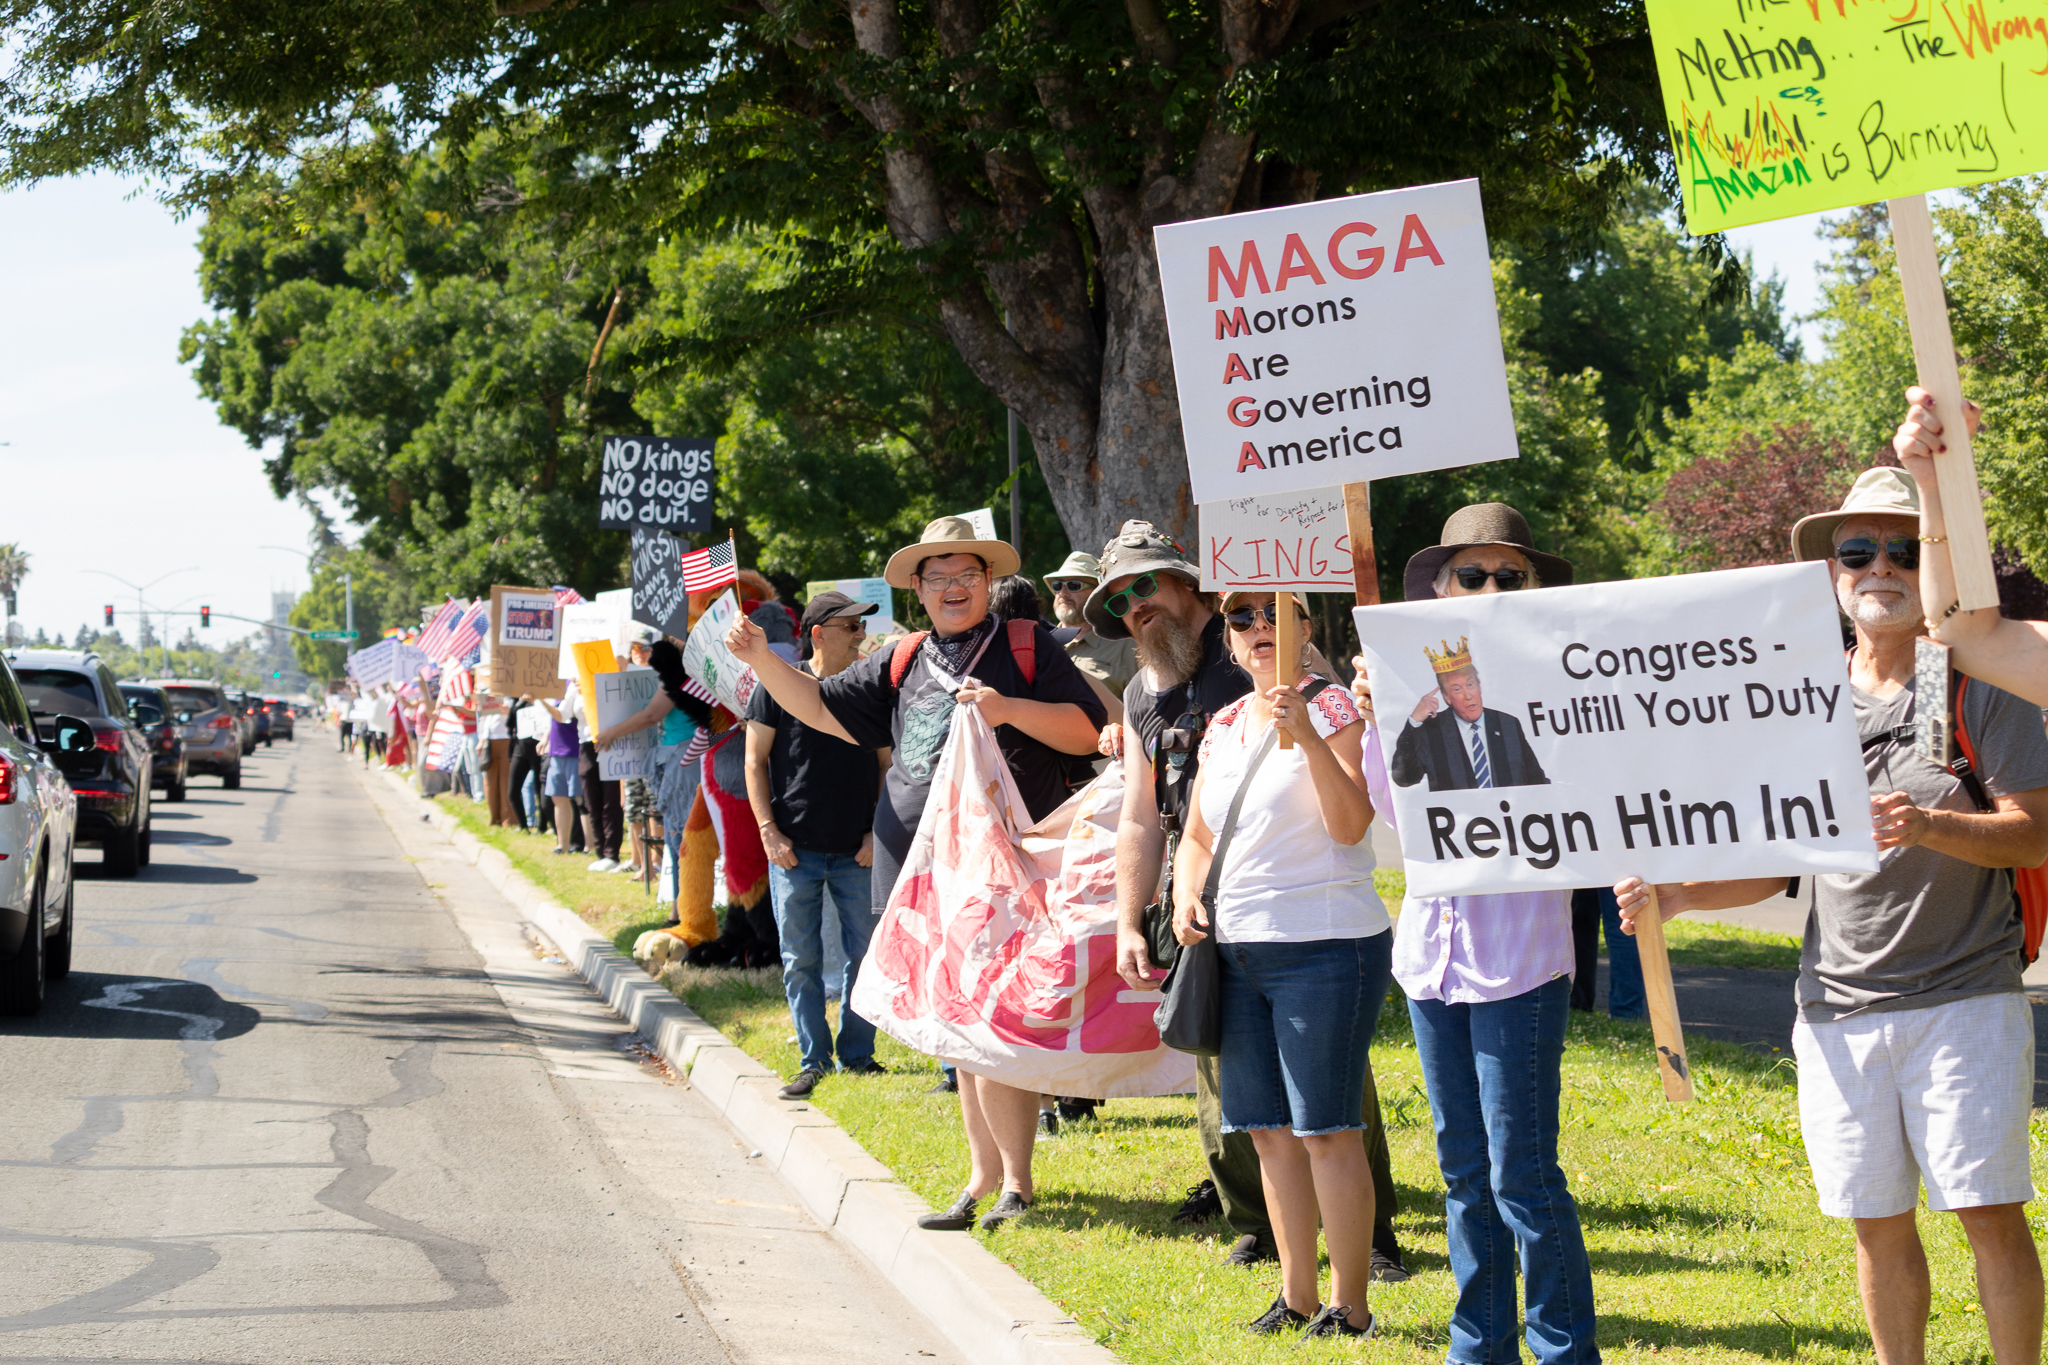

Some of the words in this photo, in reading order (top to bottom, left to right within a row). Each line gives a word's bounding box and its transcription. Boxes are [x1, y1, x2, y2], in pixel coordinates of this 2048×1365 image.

[1883, 19, 1957, 64] The
[1686, 128, 1812, 216] Amazon
[1821, 142, 1850, 182] is
[1858, 61, 2025, 185] Burning!
[1207, 213, 1446, 303] MAGA
[1215, 297, 1357, 341] Morons
[1222, 352, 1290, 385] Are
[1227, 375, 1432, 428] Governing
[602, 437, 642, 473] NO
[642, 441, 712, 479] kings
[1236, 425, 1403, 474] America
[600, 470, 635, 497] NO
[639, 471, 709, 507] doge
[600, 498, 634, 521] NO
[1228, 496, 1255, 515] Fight
[1256, 504, 1270, 517] for
[1275, 501, 1310, 519] Dignity
[1297, 509, 1326, 527] Respect
[1326, 501, 1339, 513] for
[631, 527, 646, 548] NO
[1211, 533, 1354, 580] KINGS
[508, 600, 554, 611] PRO-AMERICA
[633, 568, 670, 611] CLAWS
[647, 584, 673, 617] VOTE
[656, 576, 685, 627] SHARP
[507, 610, 534, 625] STOP
[507, 626, 553, 640] TRUMP
[493, 667, 515, 684] IN
[496, 648, 517, 667] NO
[1561, 635, 1759, 683] Congress
[1527, 693, 1626, 738] Fulfill
[1634, 690, 1731, 729] Your
[1744, 676, 1842, 724] Duty
[1426, 800, 1600, 871] Reign
[1614, 788, 1741, 851] Him
[1759, 778, 1841, 842] In!
